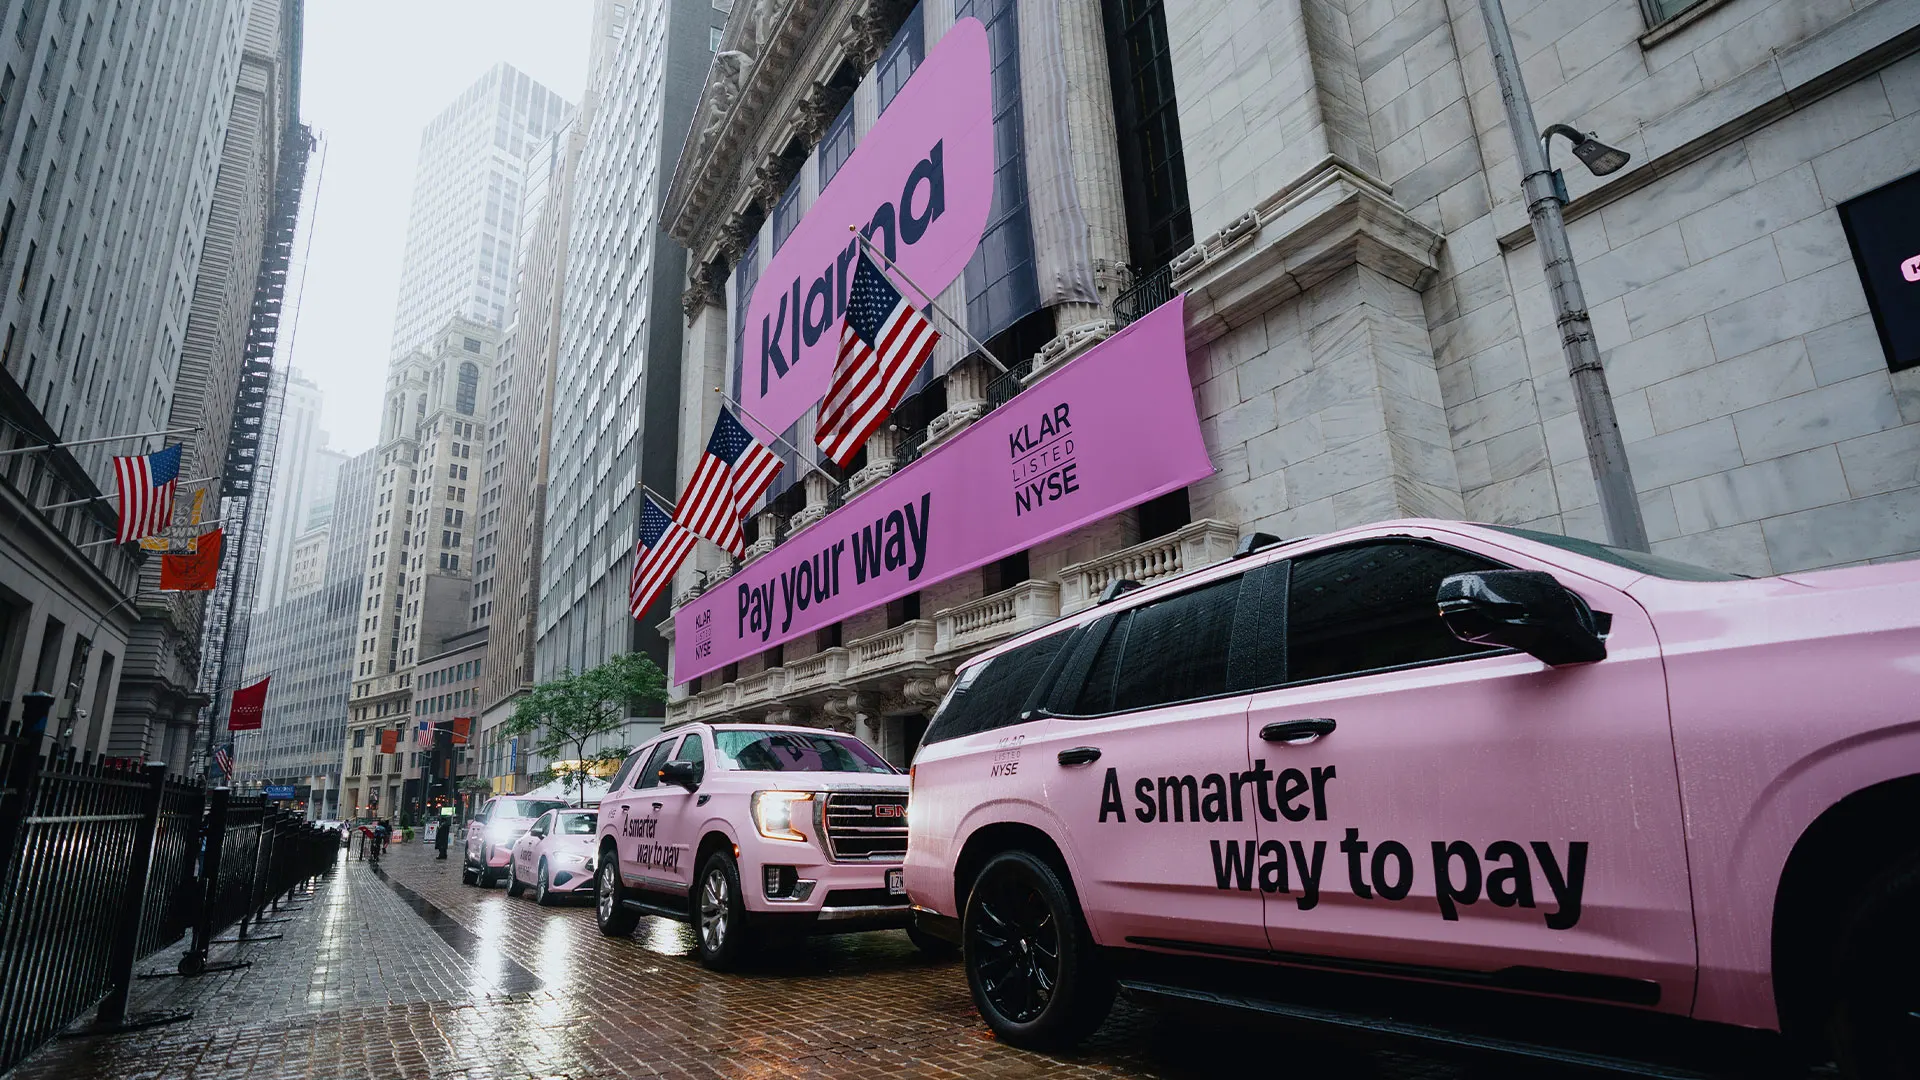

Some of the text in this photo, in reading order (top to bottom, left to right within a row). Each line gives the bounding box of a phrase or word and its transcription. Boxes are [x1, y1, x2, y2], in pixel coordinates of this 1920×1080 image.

[761, 138, 945, 399] Klarna
[1009, 403, 1071, 458] KLAR
[1012, 440, 1074, 482] LISTED
[1015, 463, 1079, 516] NYSE
[738, 492, 930, 642] Pay your way
[695, 609, 711, 630] KLAR
[695, 641, 711, 660] NYSE
[991, 762, 1018, 777] NYSE
[994, 751, 1020, 761] LISTED
[1098, 758, 1337, 823] A smarter
[622, 814, 657, 838] A smarter
[875, 804, 908, 817] GM
[637, 841, 679, 874] way to pay
[1210, 828, 1589, 930] way to pay
